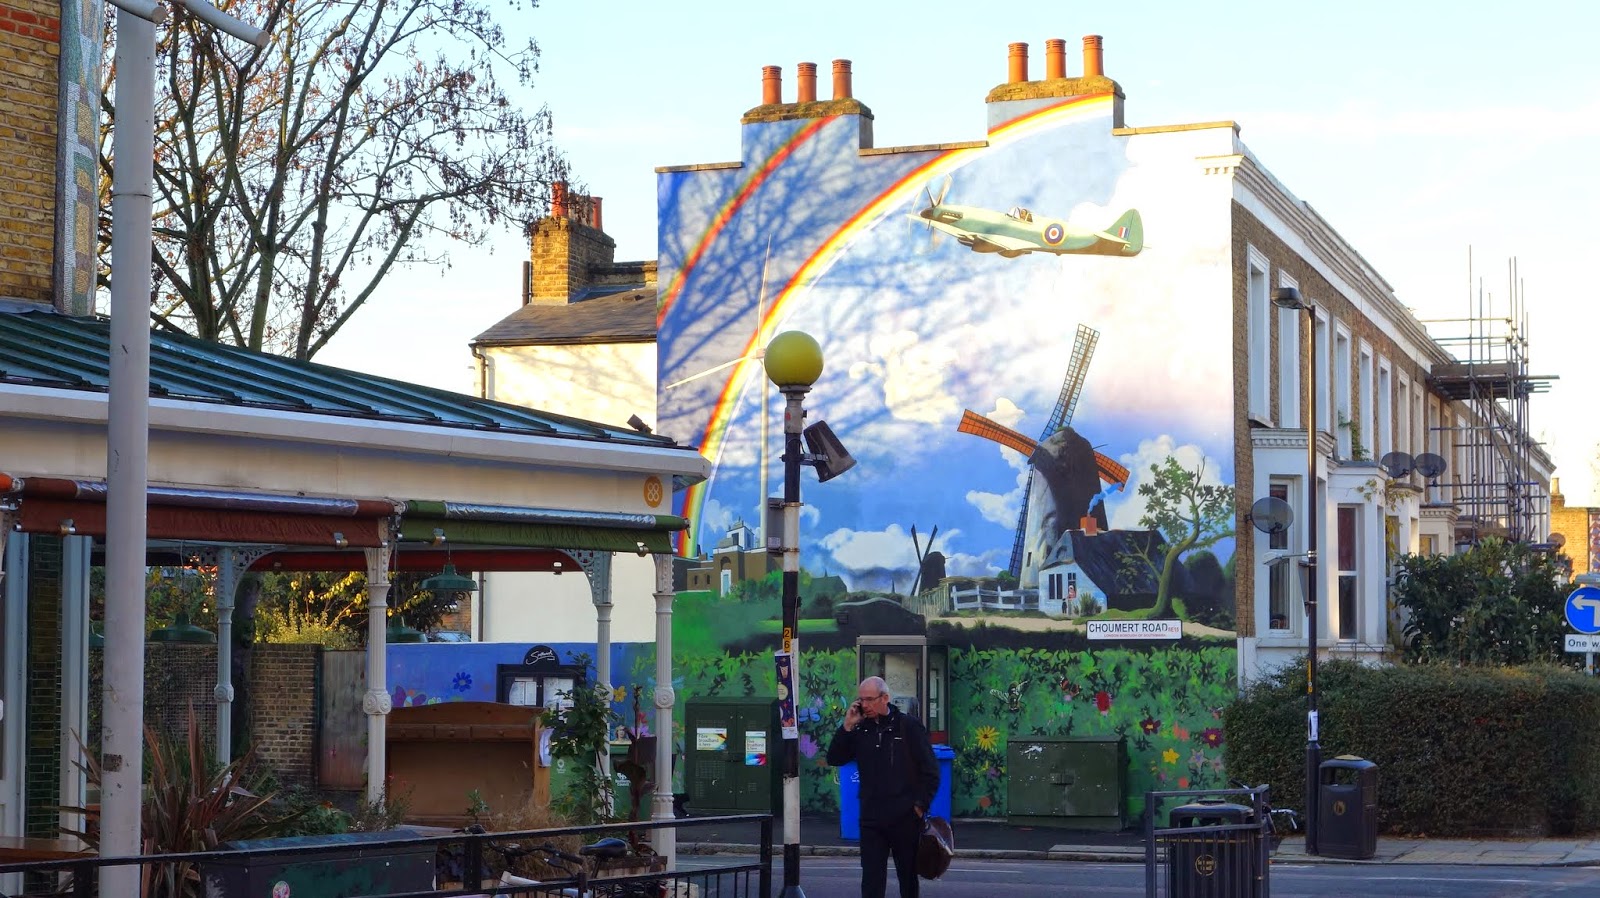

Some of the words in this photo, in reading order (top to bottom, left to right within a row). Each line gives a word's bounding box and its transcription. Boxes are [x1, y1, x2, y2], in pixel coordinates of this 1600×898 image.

[1089, 623, 1139, 632] CHOUMERT
[1142, 623, 1168, 632] ROAD
[1568, 638, 1587, 647] One
